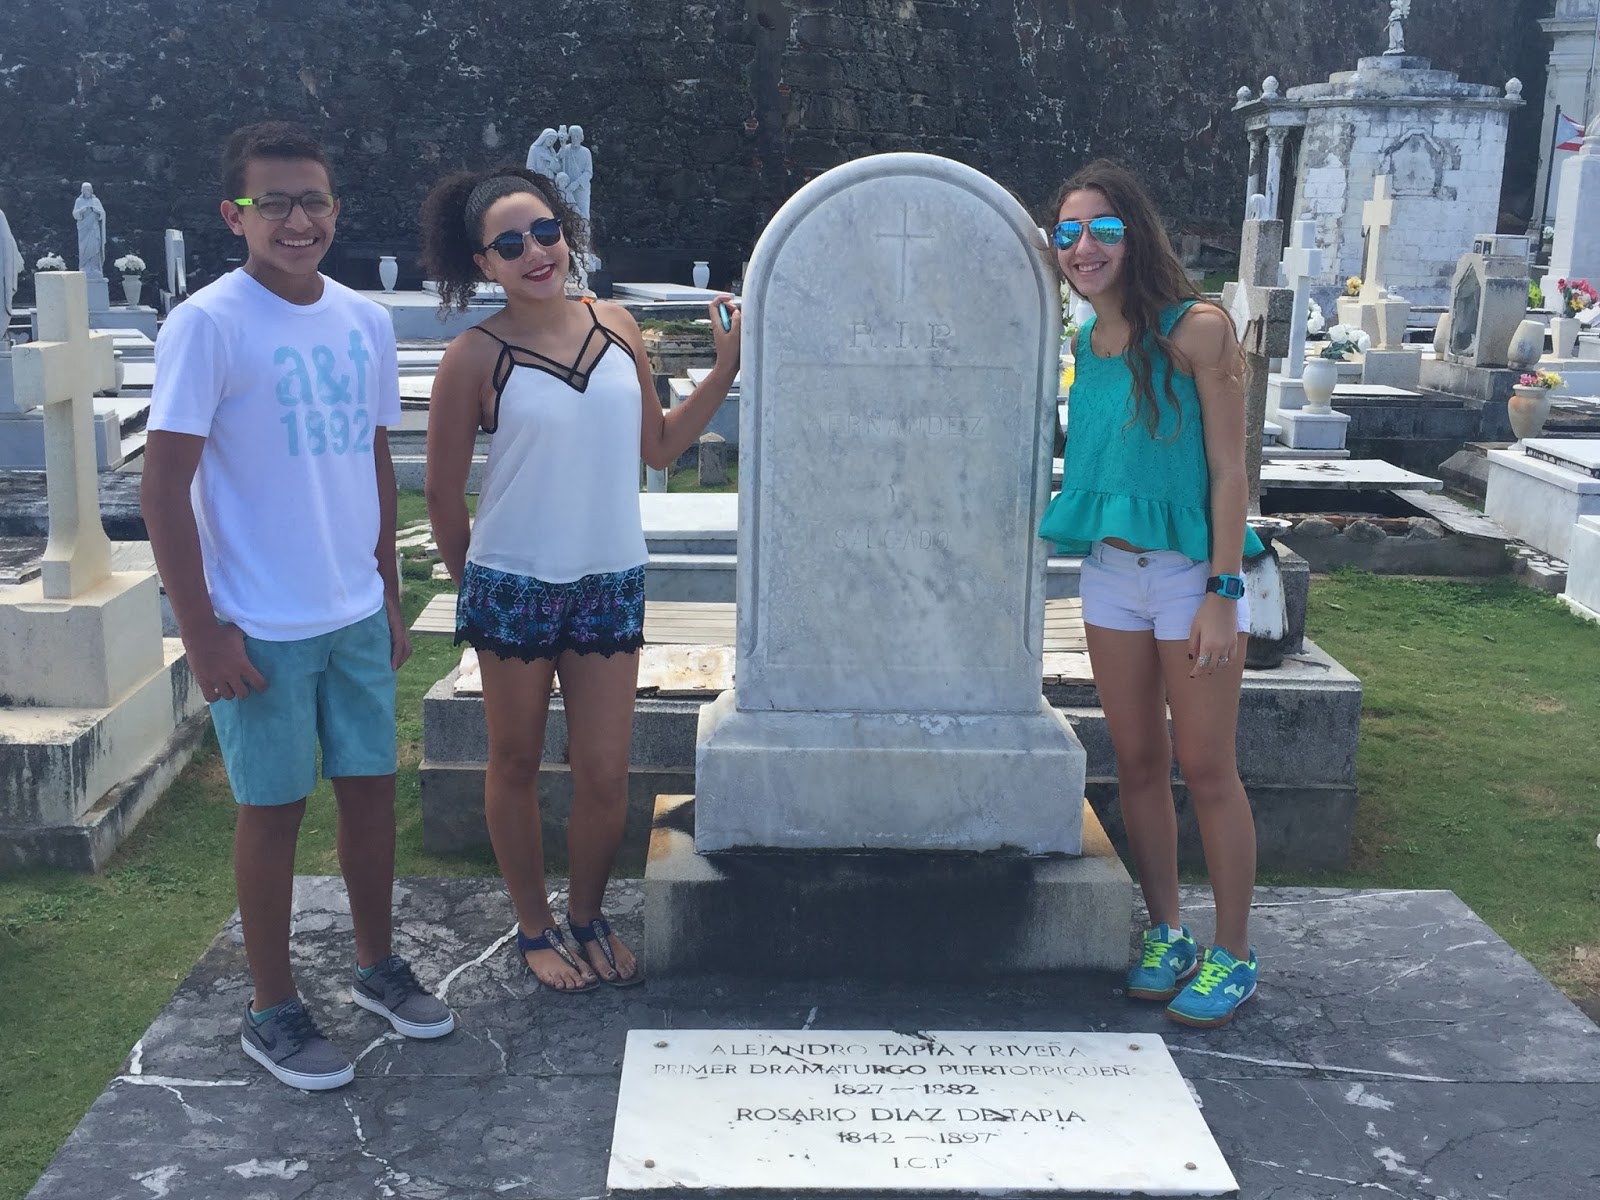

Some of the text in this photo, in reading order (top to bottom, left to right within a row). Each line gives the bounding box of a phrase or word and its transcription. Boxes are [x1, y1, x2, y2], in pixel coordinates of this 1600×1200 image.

[280, 408, 371, 457] 1892
[711, 1044, 1087, 1057] ALEJANDRO TAPIA Y RIVERA
[654, 1064, 736, 1074] PRIMER
[750, 1064, 926, 1075] DRAMATURGO
[834, 1083, 883, 1095] 1827
[923, 1084, 979, 1095] 1882
[737, 1108, 857, 1122] ROSARIO
[871, 1108, 946, 1122] DIAZ
[1003, 1108, 1087, 1122] TAPIA
[838, 1131, 896, 1144] 1842
[939, 1132, 998, 1144] 1897
